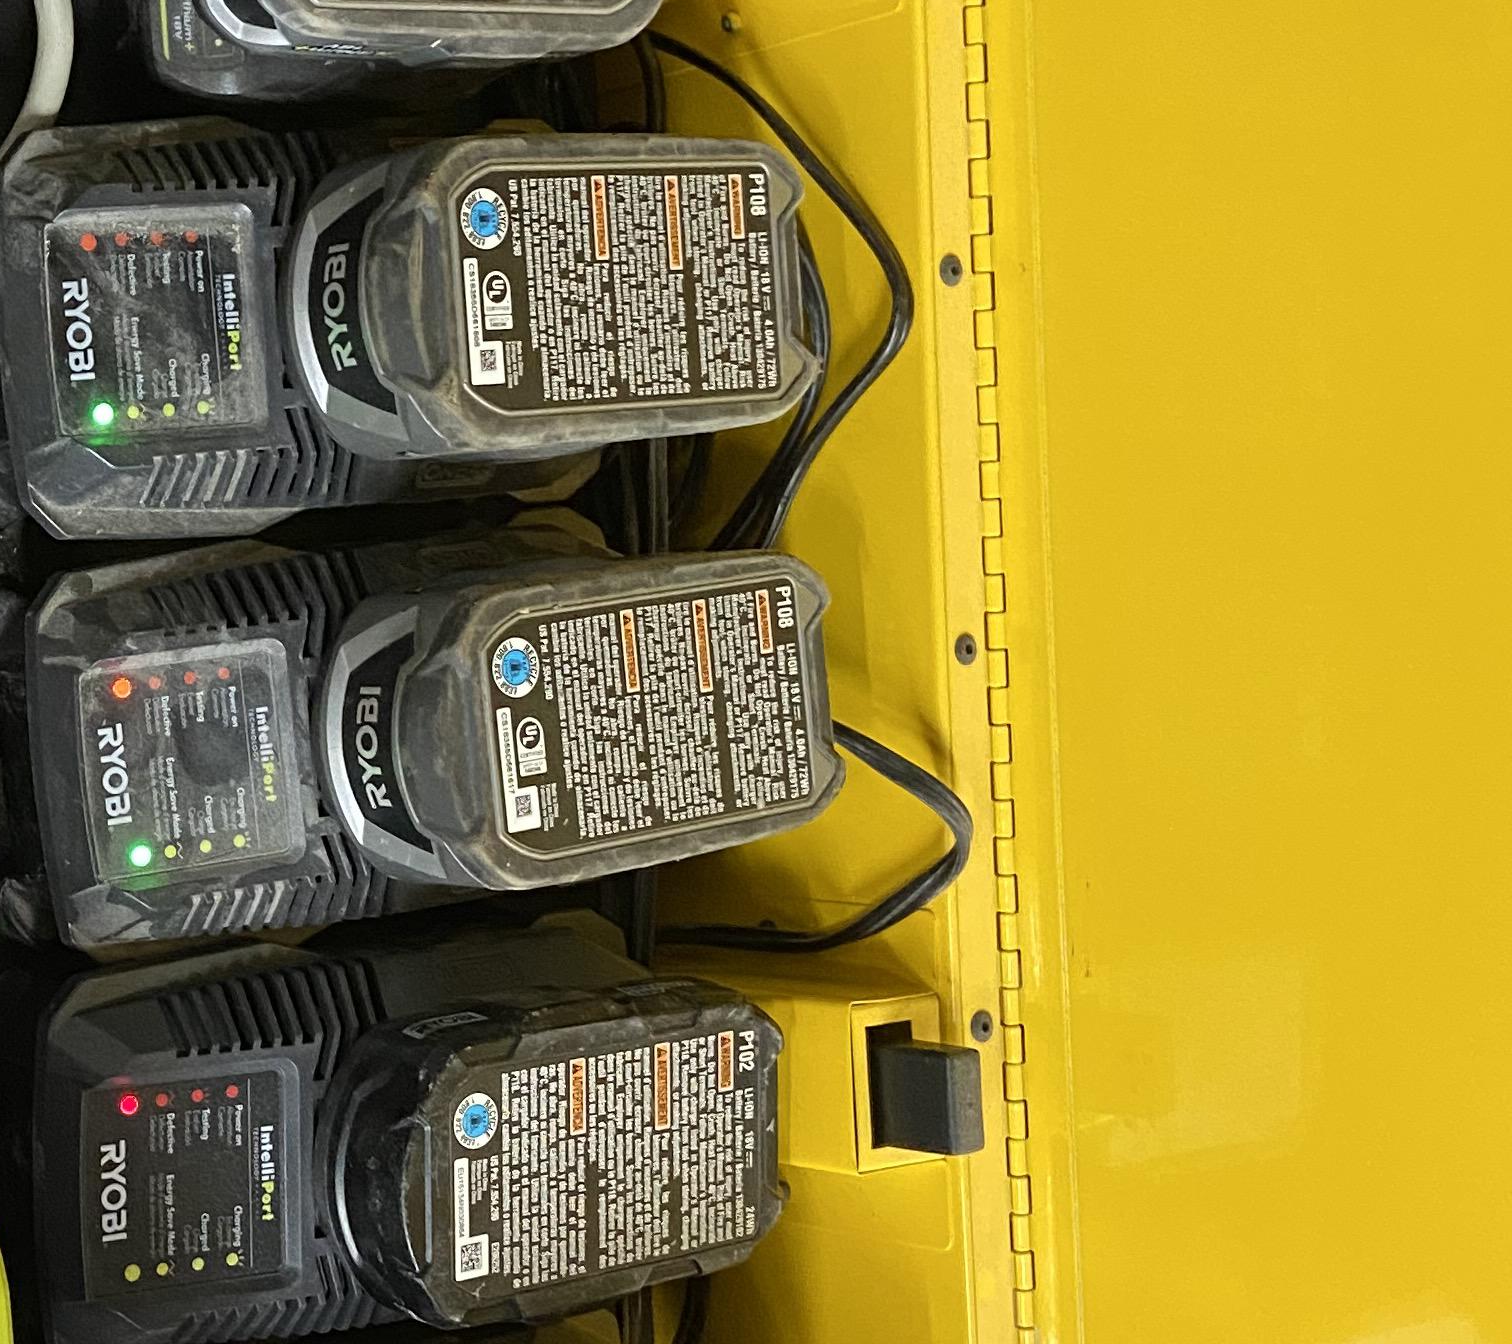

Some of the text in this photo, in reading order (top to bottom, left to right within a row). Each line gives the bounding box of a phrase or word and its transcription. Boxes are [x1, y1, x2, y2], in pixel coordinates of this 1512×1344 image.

[748, 173, 766, 215] P108
[747, 231, 758, 262] Battery
[757, 231, 768, 264] LI-ION
[194, 249, 204, 293] Power on
[761, 283, 770, 293] V
[61, 276, 95, 381] RYOBI
[220, 272, 242, 370] IntelliPort
[325, 242, 358, 373] RYOBI
[763, 318, 774, 348] 4.0Ah
[129, 316, 144, 400] Energy Save Mode
[167, 358, 179, 397] Charged
[200, 352, 211, 395] Charging
[765, 357, 777, 387] 72Wh
[771, 584, 794, 629] P108
[783, 642, 799, 676] LI-ION
[159, 694, 172, 737] Defective
[193, 690, 206, 723] Testing
[226, 685, 238, 728] Power on
[791, 694, 801, 703] V
[254, 705, 278, 803] IntelliPort
[357, 684, 395, 813] RYOBI
[793, 727, 808, 760] 4.0Ah
[96, 722, 132, 826] RYOBI
[796, 765, 812, 795] 72Wh
[164, 756, 181, 839] Energy Save Mode
[203, 794, 216, 834] Charged
[234, 786, 248, 828] Charging
[165, 1112, 176, 1154] Defective
[198, 1107, 211, 1141] Testing
[233, 1103, 244, 1146] Power on
[737, 1029, 755, 1235] P102 LI-ION 18V 24Wh
[251, 1127, 260, 1181] TECHNOLOGY
[256, 1124, 278, 1221] IntelliPort
[99, 1139, 128, 1242] RYOBI
[163, 1173, 175, 1256] Energy Save Mode
[198, 1212, 210, 1252] Charged
[230, 1204, 244, 1248] Charging
